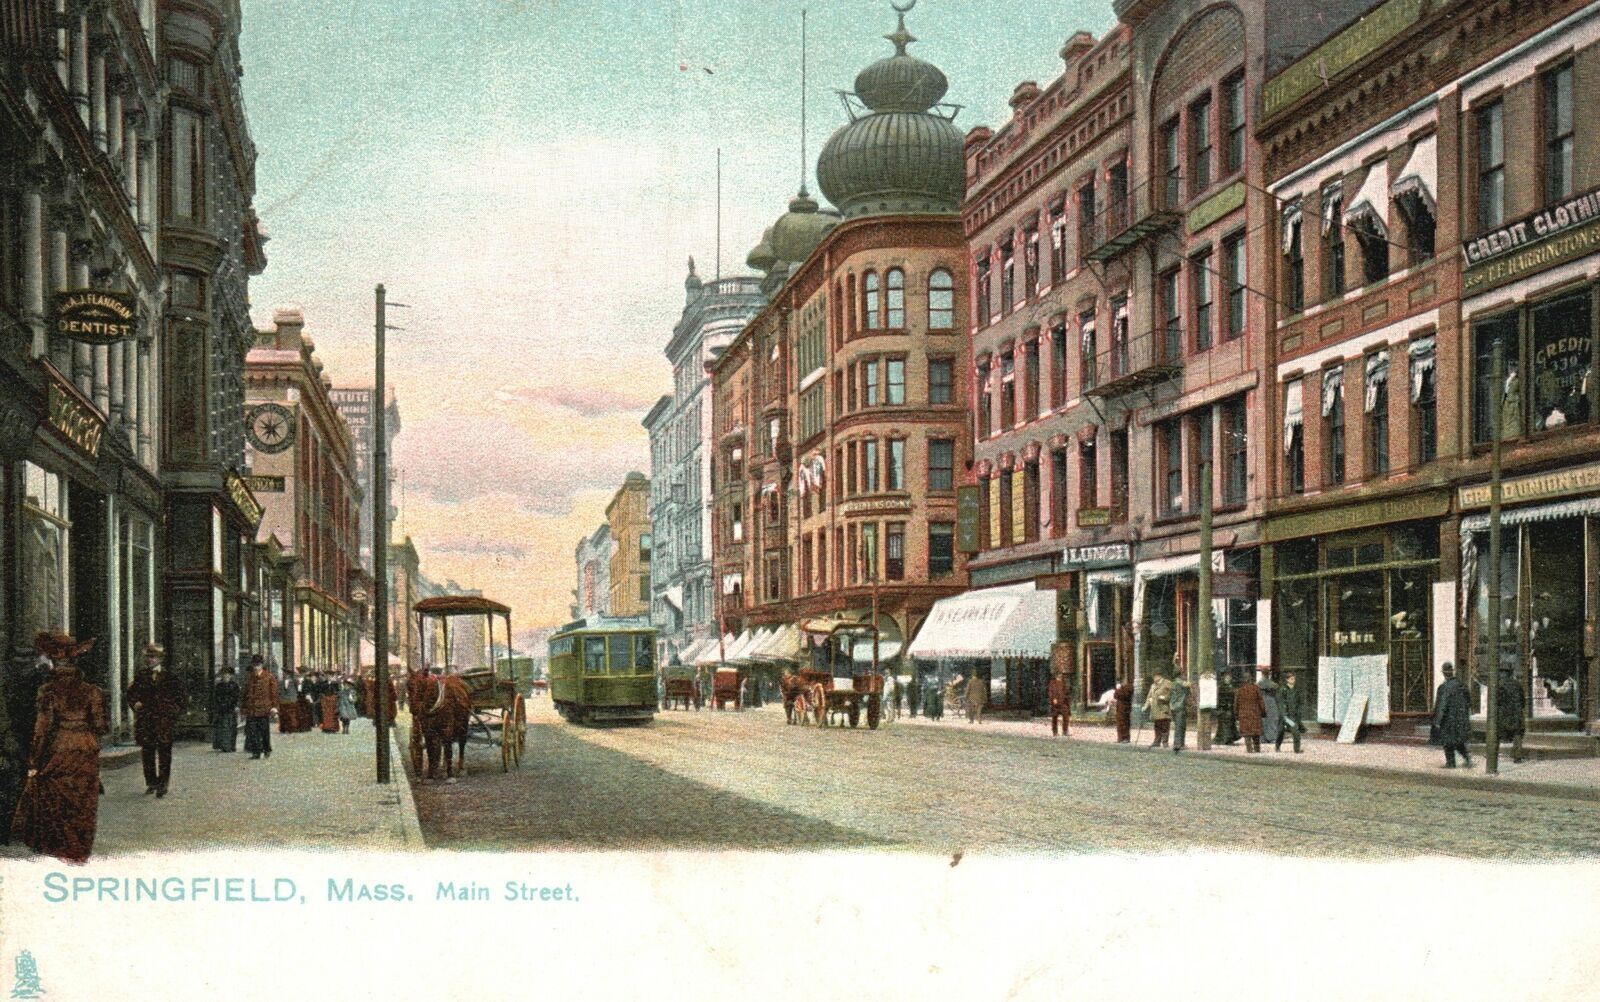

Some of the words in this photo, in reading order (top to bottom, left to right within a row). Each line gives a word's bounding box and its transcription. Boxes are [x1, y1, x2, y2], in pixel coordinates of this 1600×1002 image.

[1468, 222, 1527, 260] CREDIT
[59, 320, 131, 336] DENTIST
[1536, 336, 1591, 365] CREDIT
[1463, 481, 1516, 504] GRAD
[1517, 471, 1570, 498] UNION
[1068, 544, 1130, 563] LUNCH
